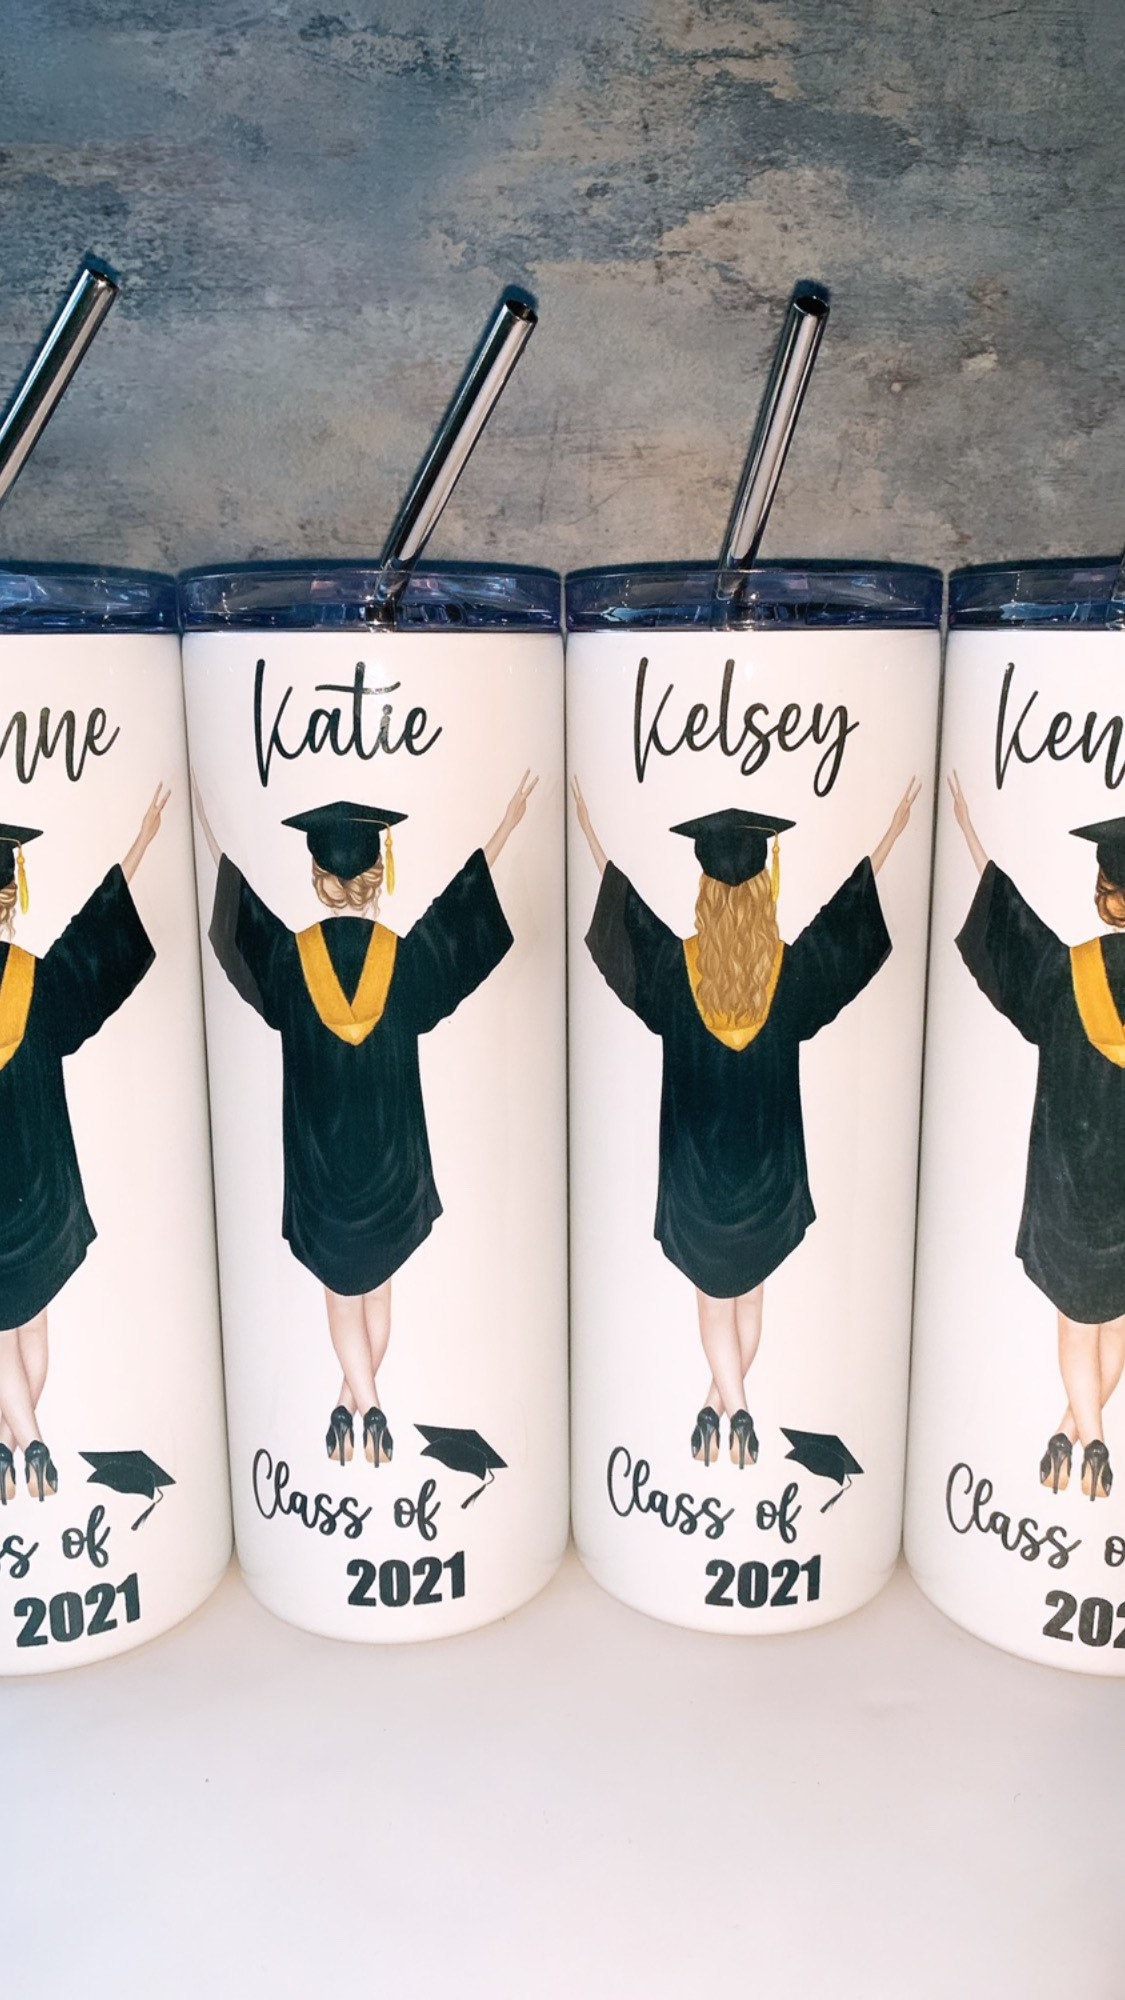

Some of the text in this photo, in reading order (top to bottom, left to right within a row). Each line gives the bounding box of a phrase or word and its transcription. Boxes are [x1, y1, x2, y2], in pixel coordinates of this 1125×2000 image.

[253, 658, 443, 788] Katie
[634, 656, 860, 798] Kelsey
[61, 1504, 111, 1568] of
[252, 1448, 441, 1542] Class of
[607, 1446, 802, 1544] Class of
[945, 1462, 1083, 1570] Class
[13, 1572, 141, 1648] 2021
[346, 1550, 466, 1608] 2021
[705, 1554, 821, 1609] 2021
